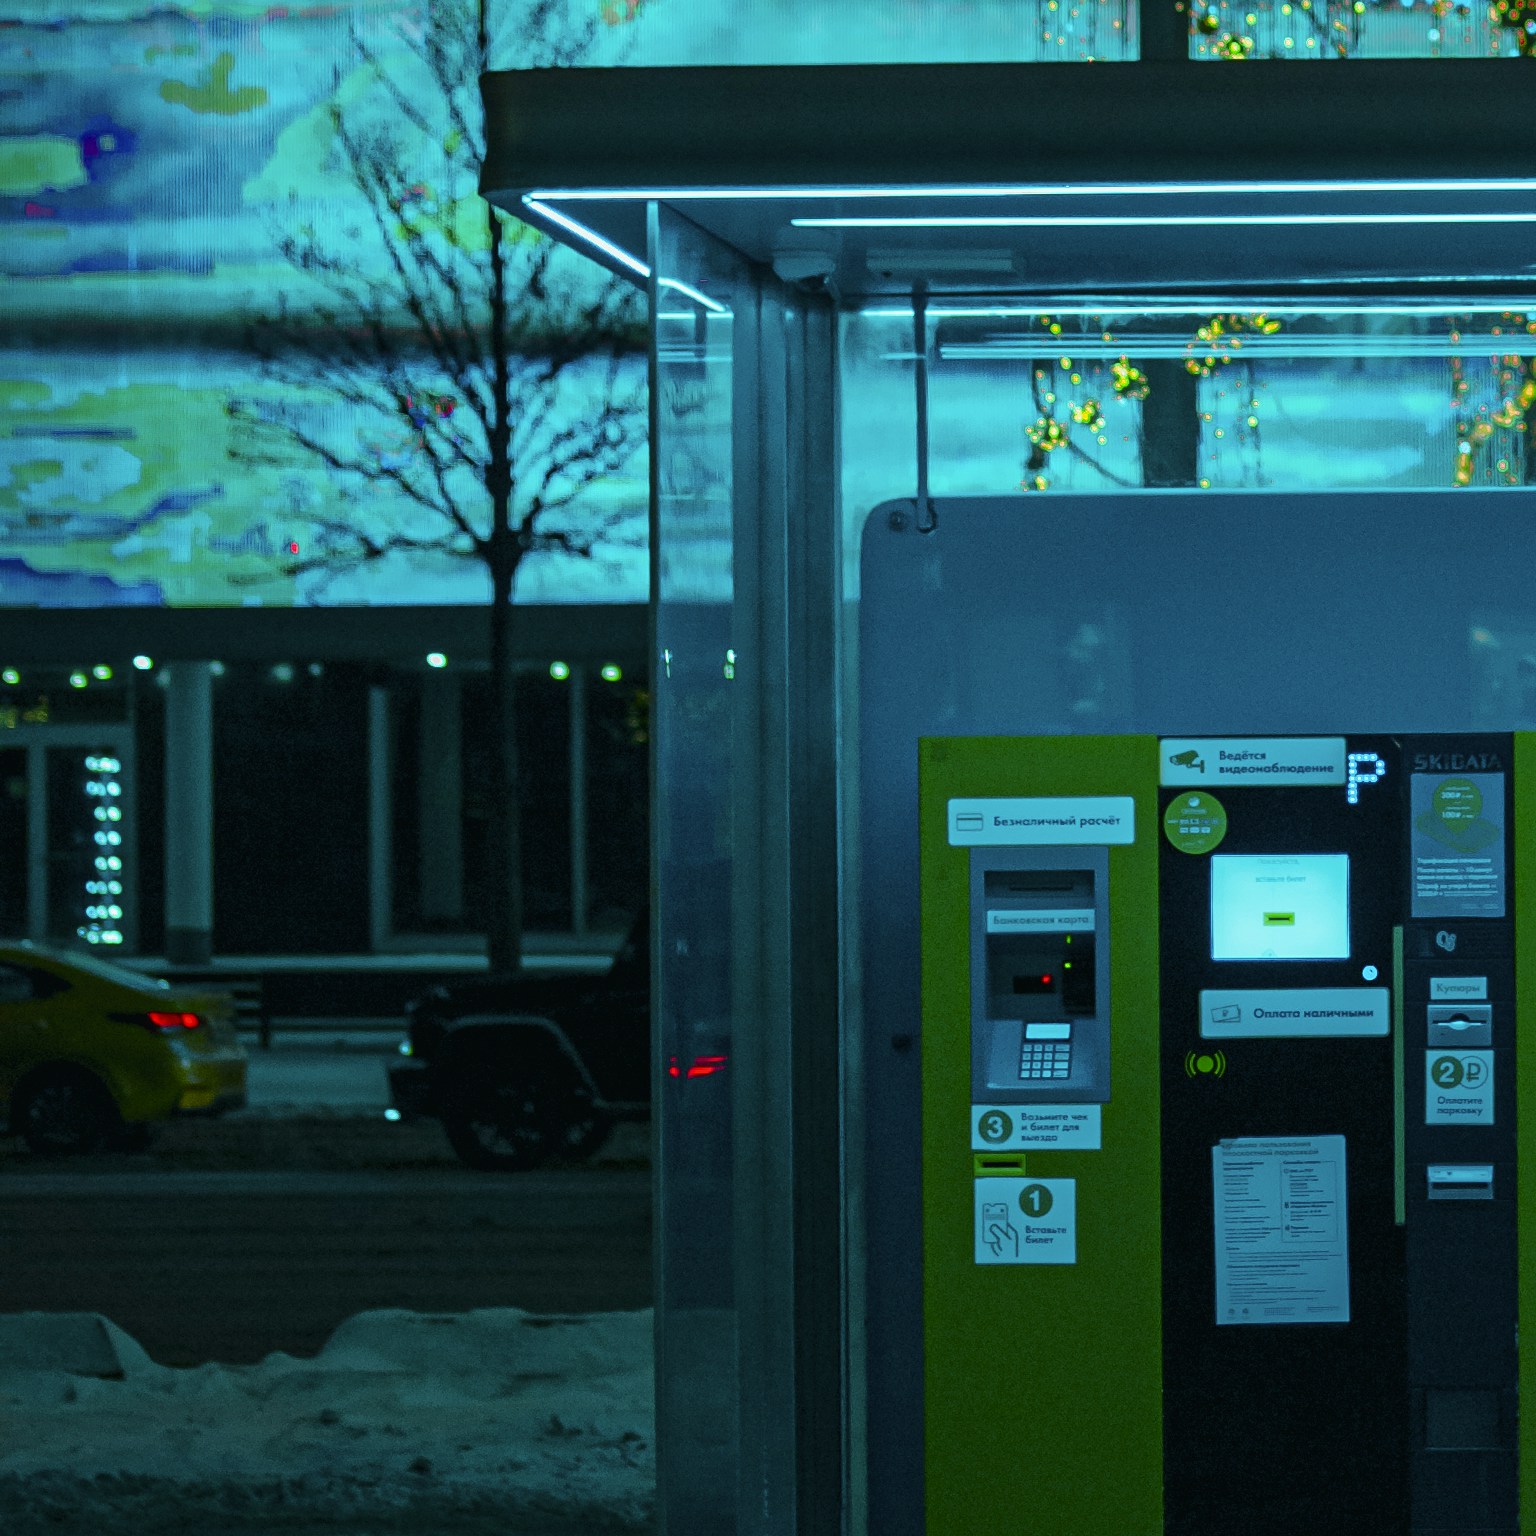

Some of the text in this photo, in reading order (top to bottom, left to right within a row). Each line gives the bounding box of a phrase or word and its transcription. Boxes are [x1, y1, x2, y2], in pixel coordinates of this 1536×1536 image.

[1219, 750, 1266, 762] Ведётся
[1413, 753, 1503, 771] SKIDATA
[1219, 763, 1334, 775] видеонаблюдение
[993, 815, 1121, 828] Безналичный расчёт
[993, 915, 1089, 926] Банковская карта
[1436, 983, 1480, 993] Купюры
[1253, 1008, 1374, 1019] Оплата наличными
[1438, 1062, 1455, 1084] 2
[1437, 1096, 1483, 1106] Оплатите
[1021, 1112, 1069, 1122] Возьмите
[1437, 1107, 1483, 1116] парковку
[986, 1116, 1004, 1139] 3
[1030, 1122, 1059, 1132] билет
[1062, 1124, 1080, 1132] для
[1021, 1135, 1058, 1143] выезда
[1029, 1189, 1040, 1212] 1
[1025, 1225, 1067, 1234] Вставьте
[1025, 1235, 1053, 1244] билет
